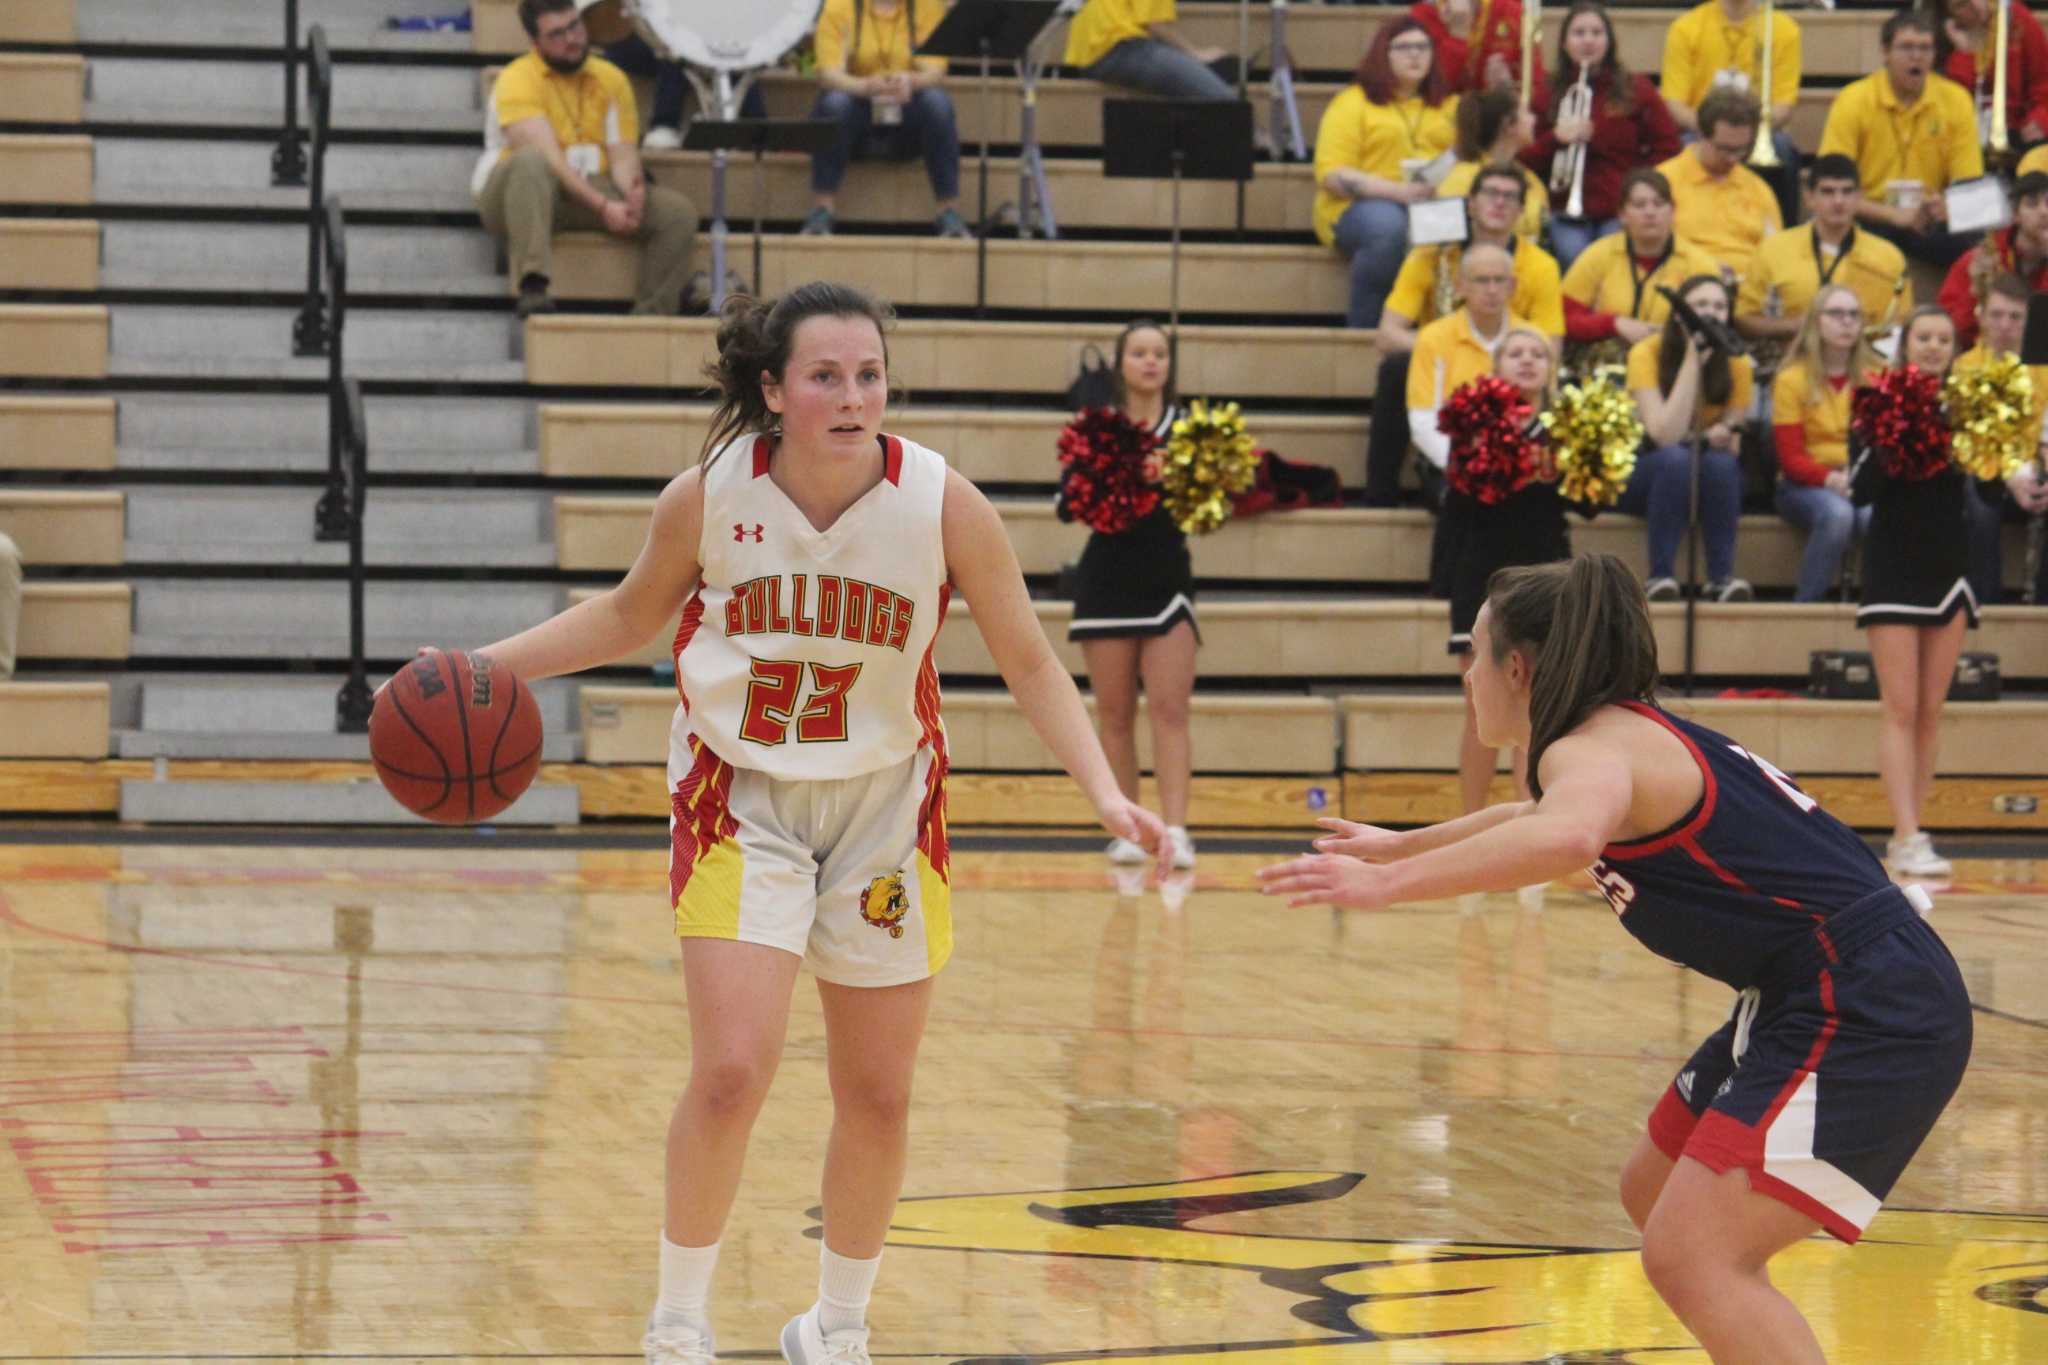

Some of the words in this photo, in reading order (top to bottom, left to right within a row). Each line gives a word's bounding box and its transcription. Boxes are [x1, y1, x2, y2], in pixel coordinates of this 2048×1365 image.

[725, 574, 915, 652] BULLDOGS
[739, 657, 863, 746] 23
[0, 1118, 408, 1254] ARENA
